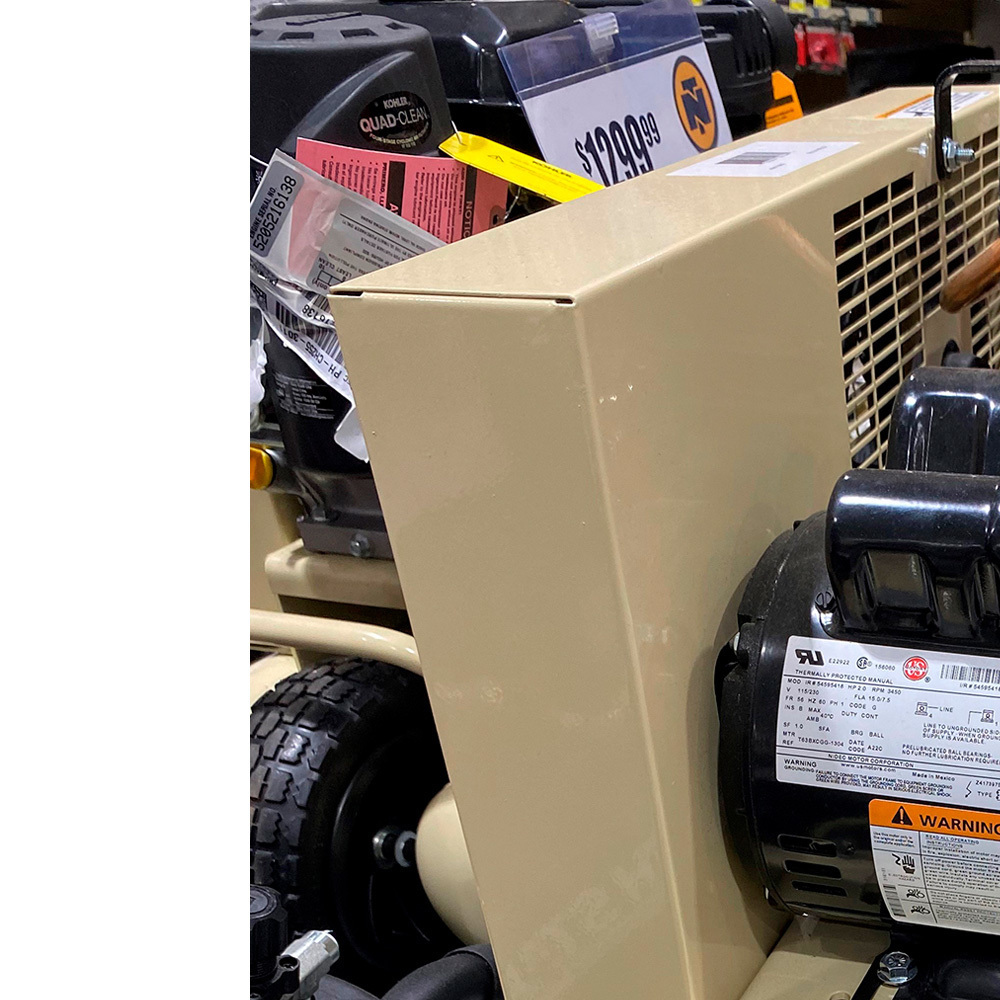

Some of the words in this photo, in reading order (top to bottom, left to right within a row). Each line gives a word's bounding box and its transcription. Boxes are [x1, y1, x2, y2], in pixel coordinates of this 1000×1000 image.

[382, 97, 410, 109] KOHLER
[360, 107, 428, 132] QUAD-CLEAN
[253, 176, 296, 251] 5205216138
[258, 198, 271, 218] SERIAL
[462, 200, 473, 239] NOTIC
[317, 256, 335, 269] CLEAN
[795, 669, 830, 677] THERMALLY
[831, 673, 867, 681] PROTECTED
[947, 725, 989, 734] UNGROUNDED
[902, 744, 946, 754] PRELUBRICATED
[784, 759, 817, 768] WARNING
[870, 758, 914, 768] CORPORATION
[937, 753, 974, 762] LUBRICATION
